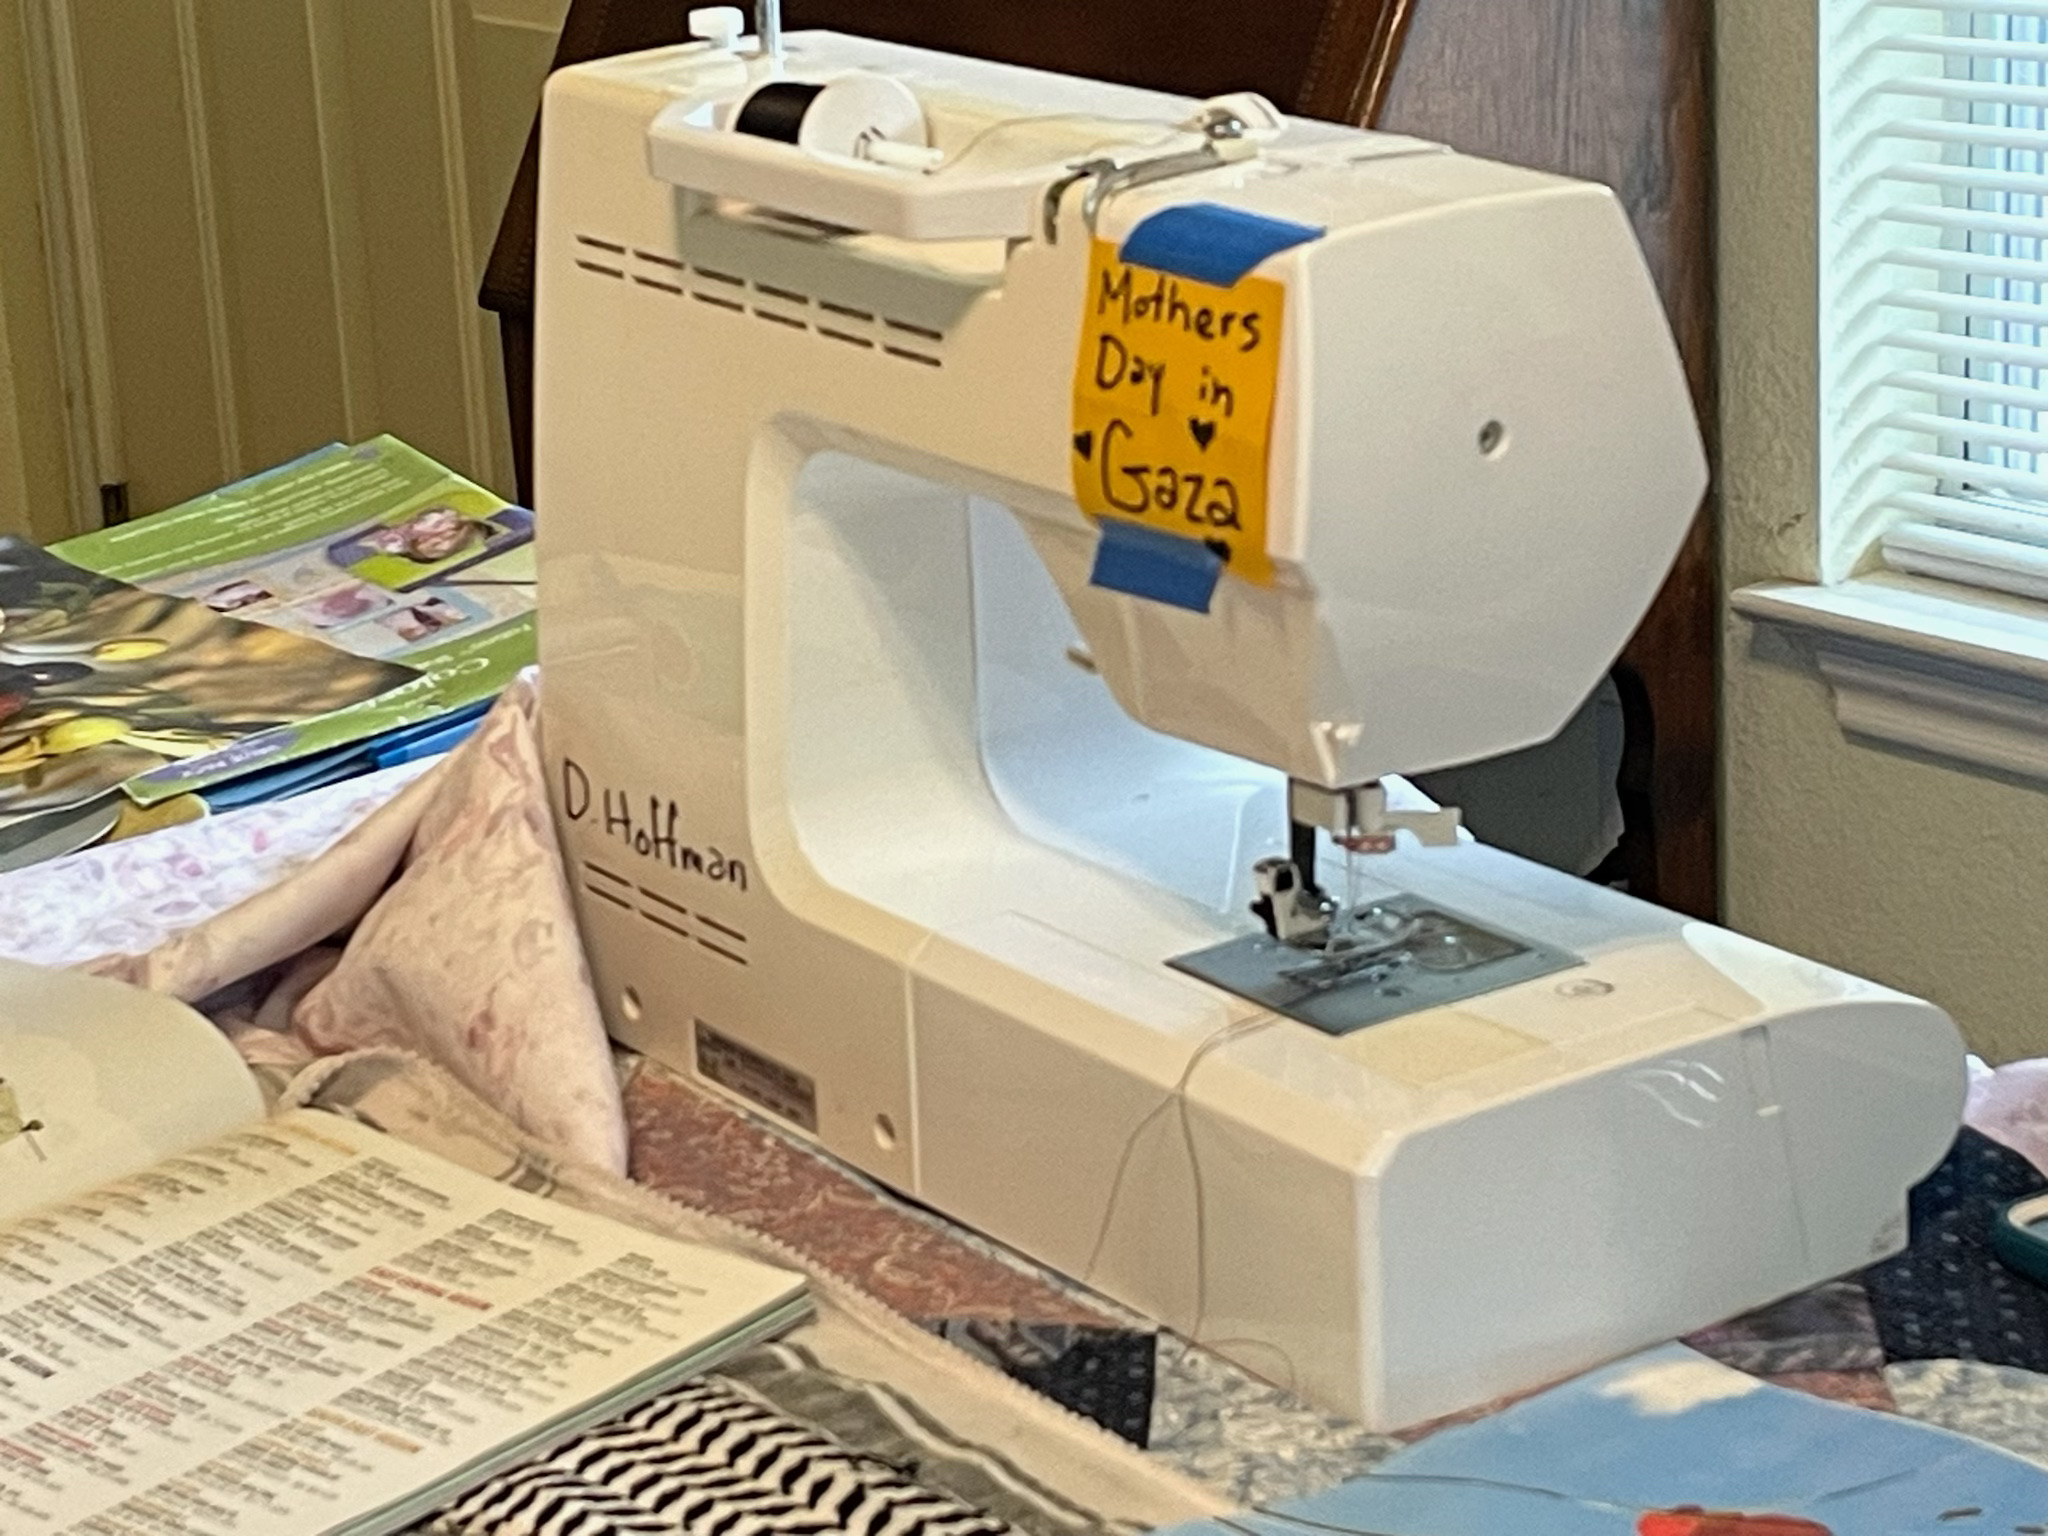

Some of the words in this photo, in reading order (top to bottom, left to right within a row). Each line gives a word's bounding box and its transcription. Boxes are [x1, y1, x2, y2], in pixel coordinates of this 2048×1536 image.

[1097, 266, 1261, 353] Mothers
[1094, 333, 1166, 417] Day
[1199, 366, 1234, 418] in
[1101, 418, 1243, 532] Gaza
